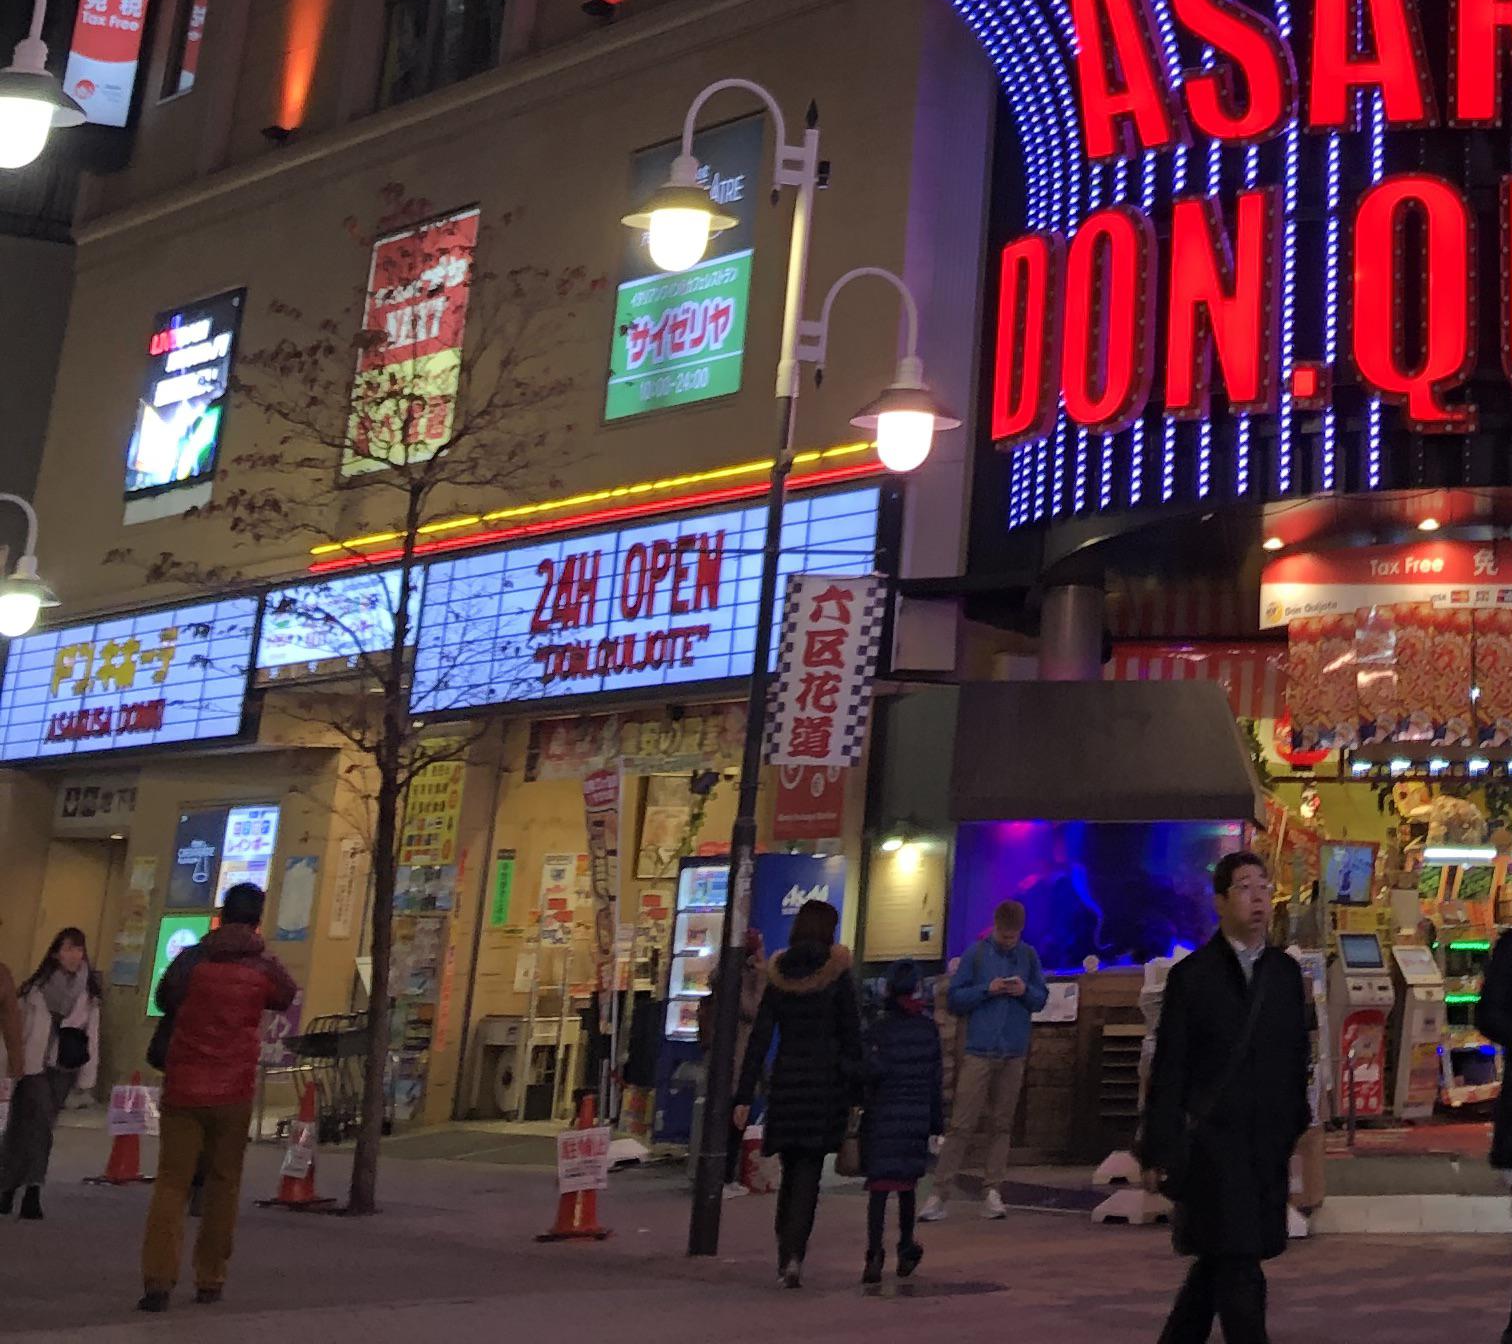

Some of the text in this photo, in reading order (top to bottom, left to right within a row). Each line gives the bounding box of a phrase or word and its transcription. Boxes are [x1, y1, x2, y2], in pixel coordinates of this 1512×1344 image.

[82, 10, 140, 31] Tax Free
[627, 297, 735, 370] サイゼリヤ
[529, 529, 726, 635] 24H OPEN
[1370, 557, 1444, 576] Tax Free
[787, 585, 856, 759] 六区花道
